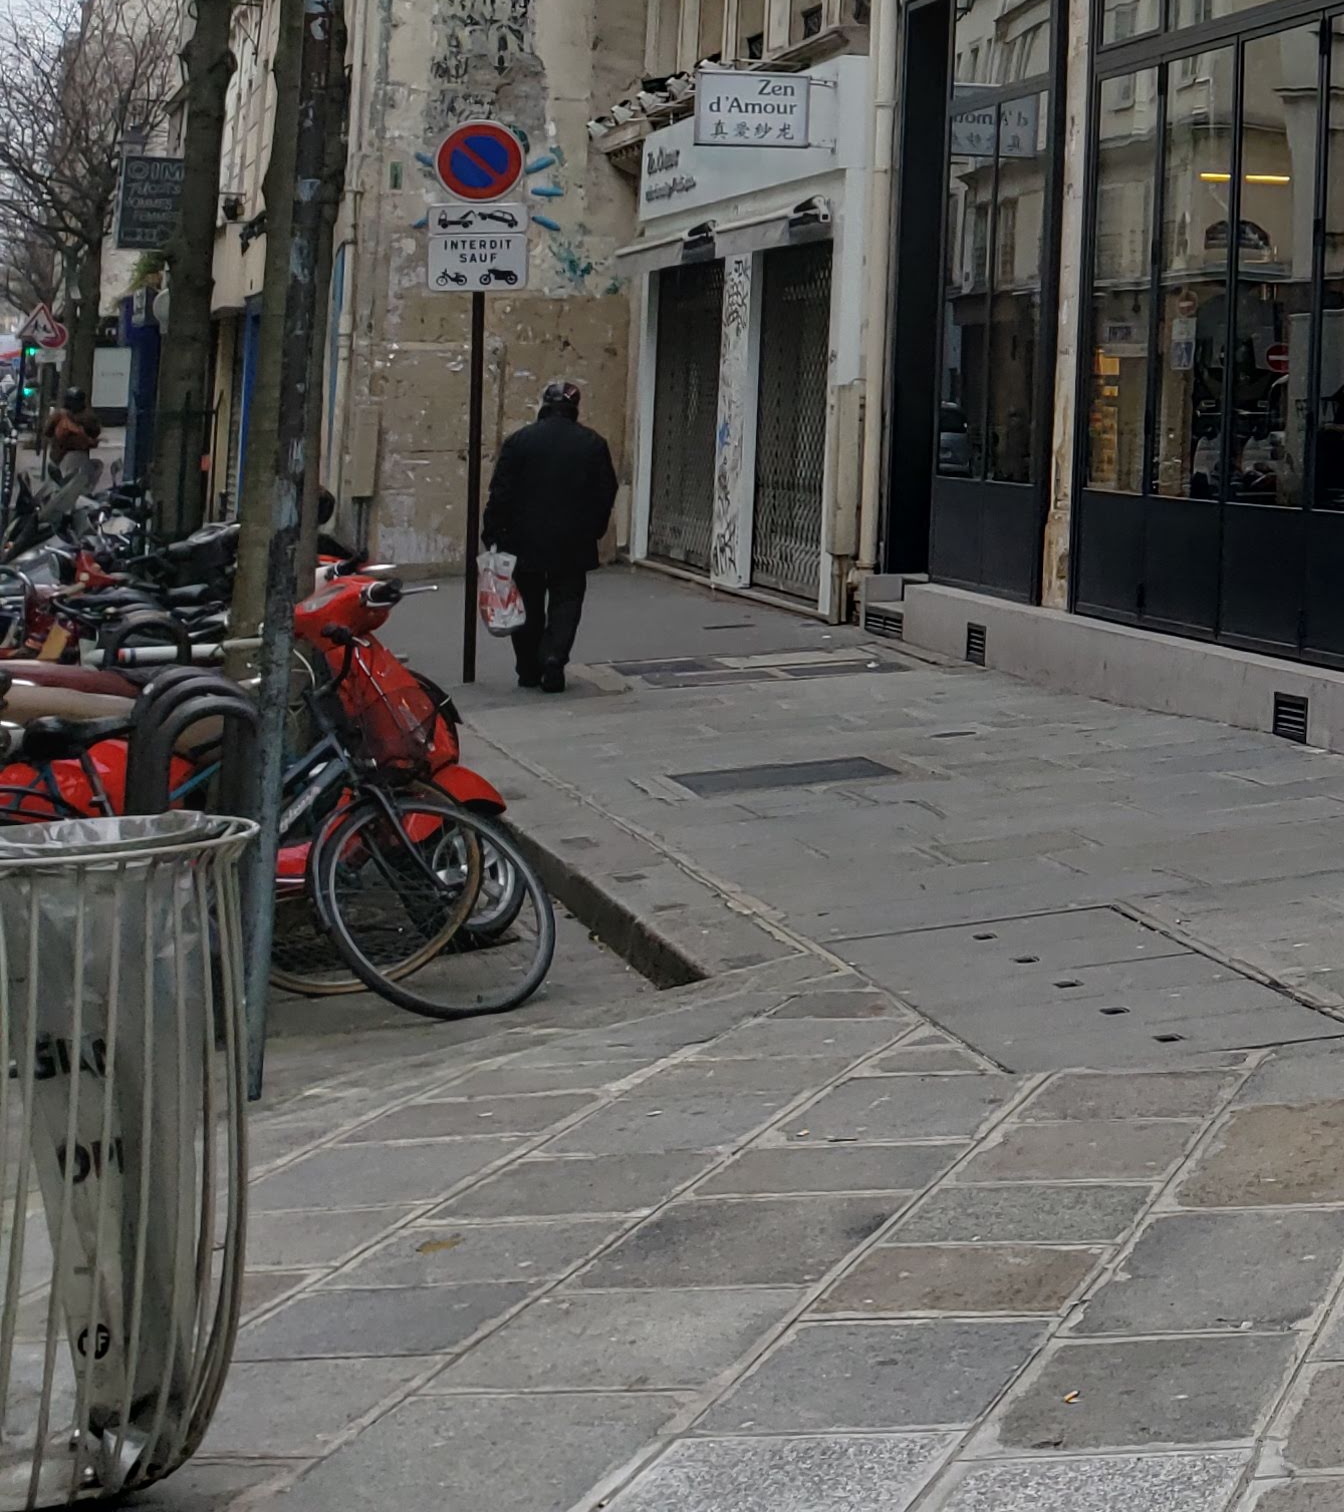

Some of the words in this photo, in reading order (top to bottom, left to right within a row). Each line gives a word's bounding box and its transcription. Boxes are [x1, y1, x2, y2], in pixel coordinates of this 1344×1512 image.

[757, 79, 796, 97] Zen
[708, 96, 798, 115] d'Amour
[443, 239, 512, 250] INTERDIT
[459, 252, 498, 264] SAUF
